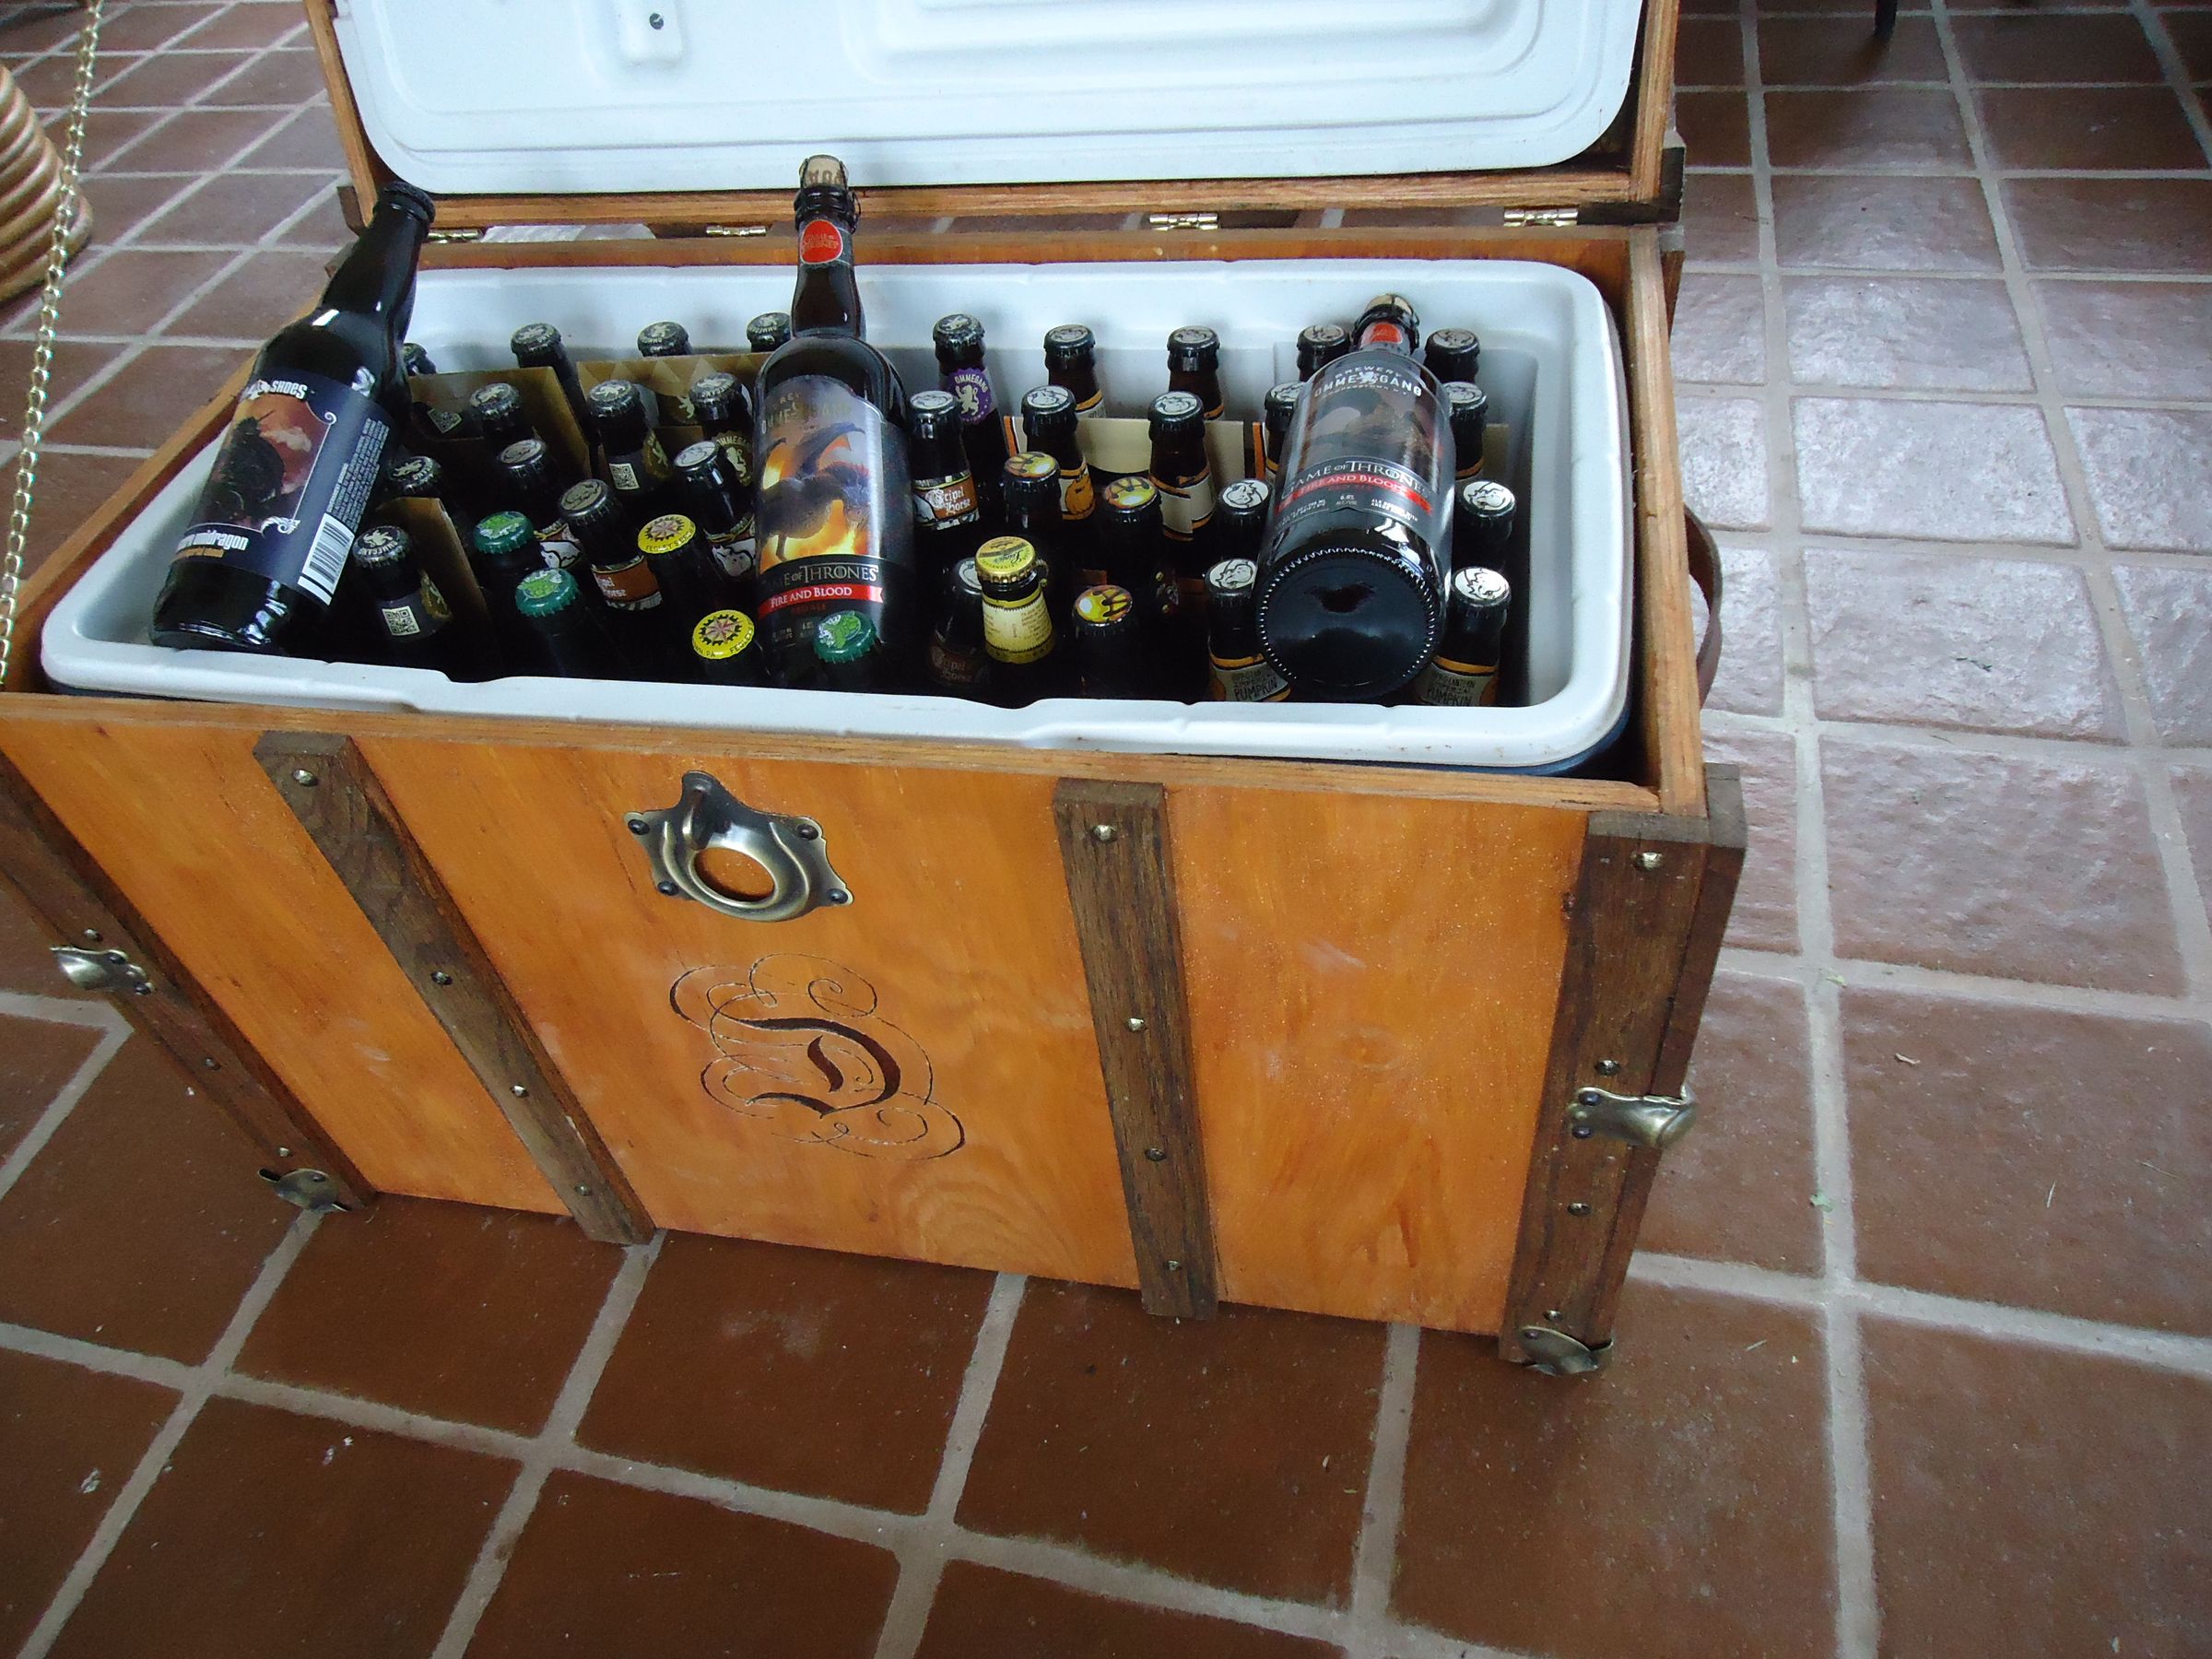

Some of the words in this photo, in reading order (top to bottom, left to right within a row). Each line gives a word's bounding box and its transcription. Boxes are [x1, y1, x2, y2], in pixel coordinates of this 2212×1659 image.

[954, 373, 989, 394] OMMEGANG
[1327, 475, 1357, 484] AND
[1359, 474, 1405, 493] BLOOD
[799, 562, 879, 584] THRONES
[771, 594, 788, 608] FIRE
[790, 590, 812, 602] AND
[813, 586, 853, 597] BLOOD
